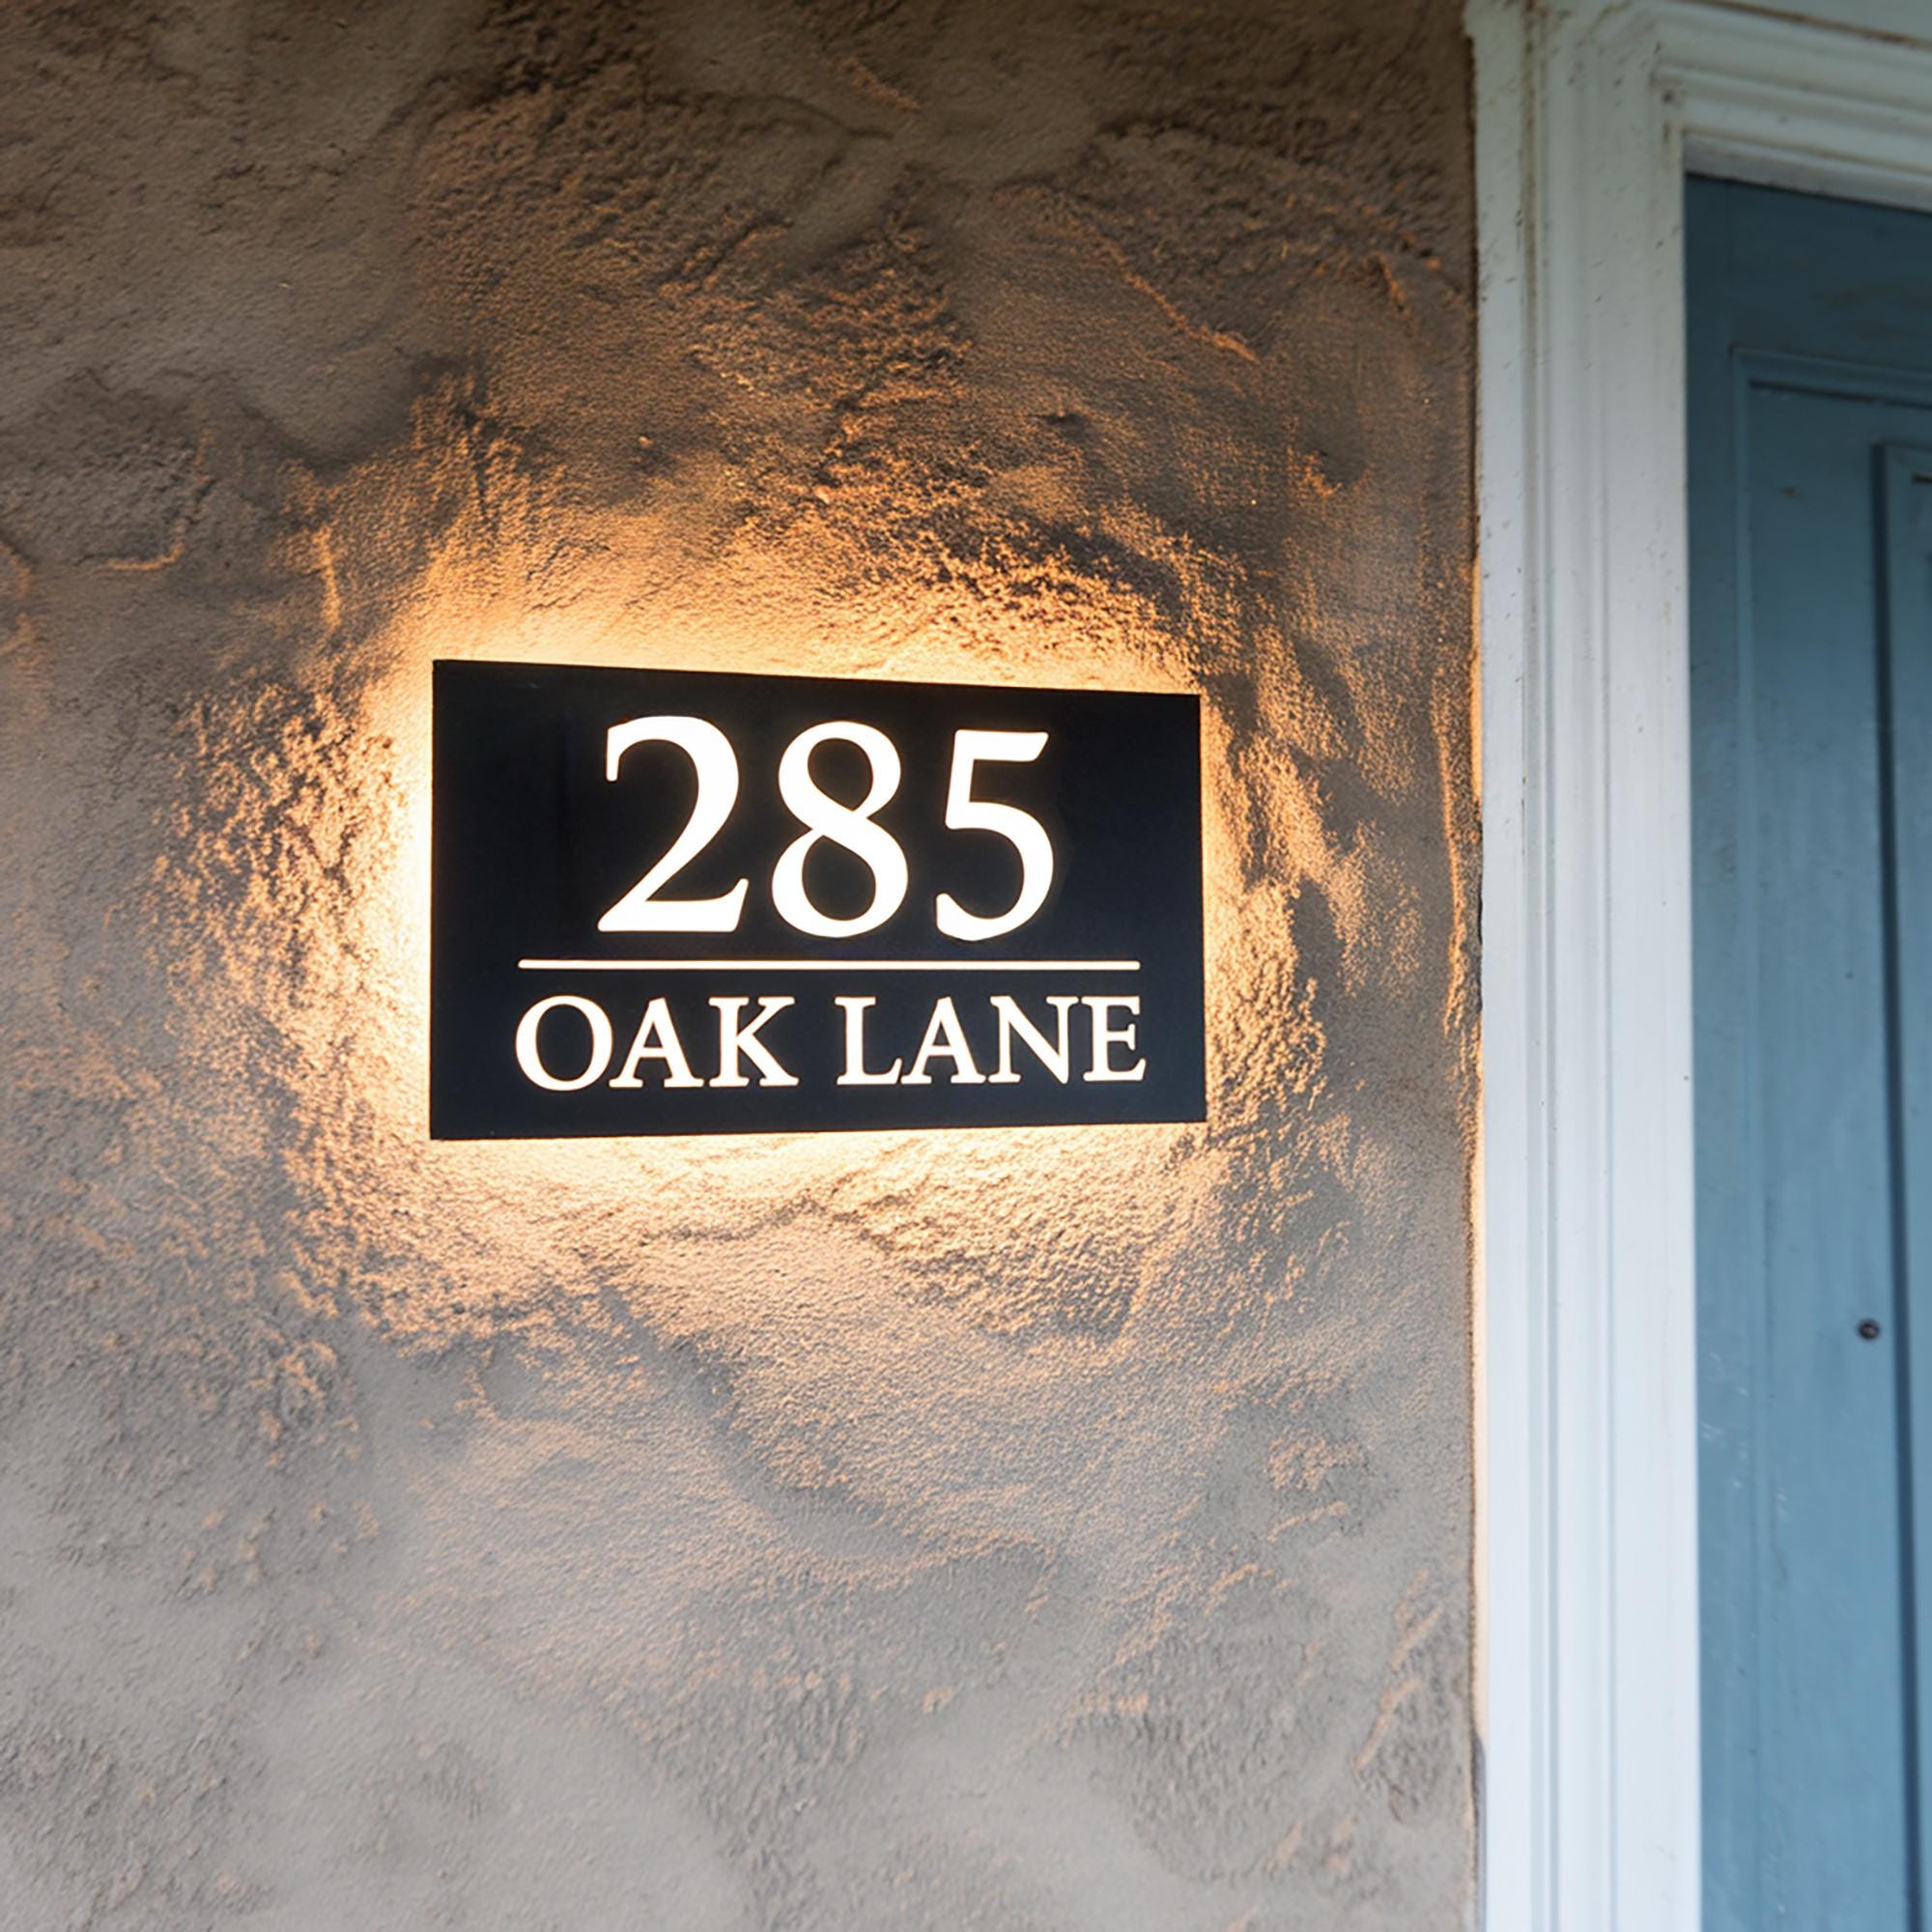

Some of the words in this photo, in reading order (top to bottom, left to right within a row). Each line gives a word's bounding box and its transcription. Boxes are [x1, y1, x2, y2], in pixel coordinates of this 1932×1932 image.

[598, 716, 1054, 941] 285
[515, 995, 800, 1092] OAK
[835, 995, 1147, 1086] LANE
